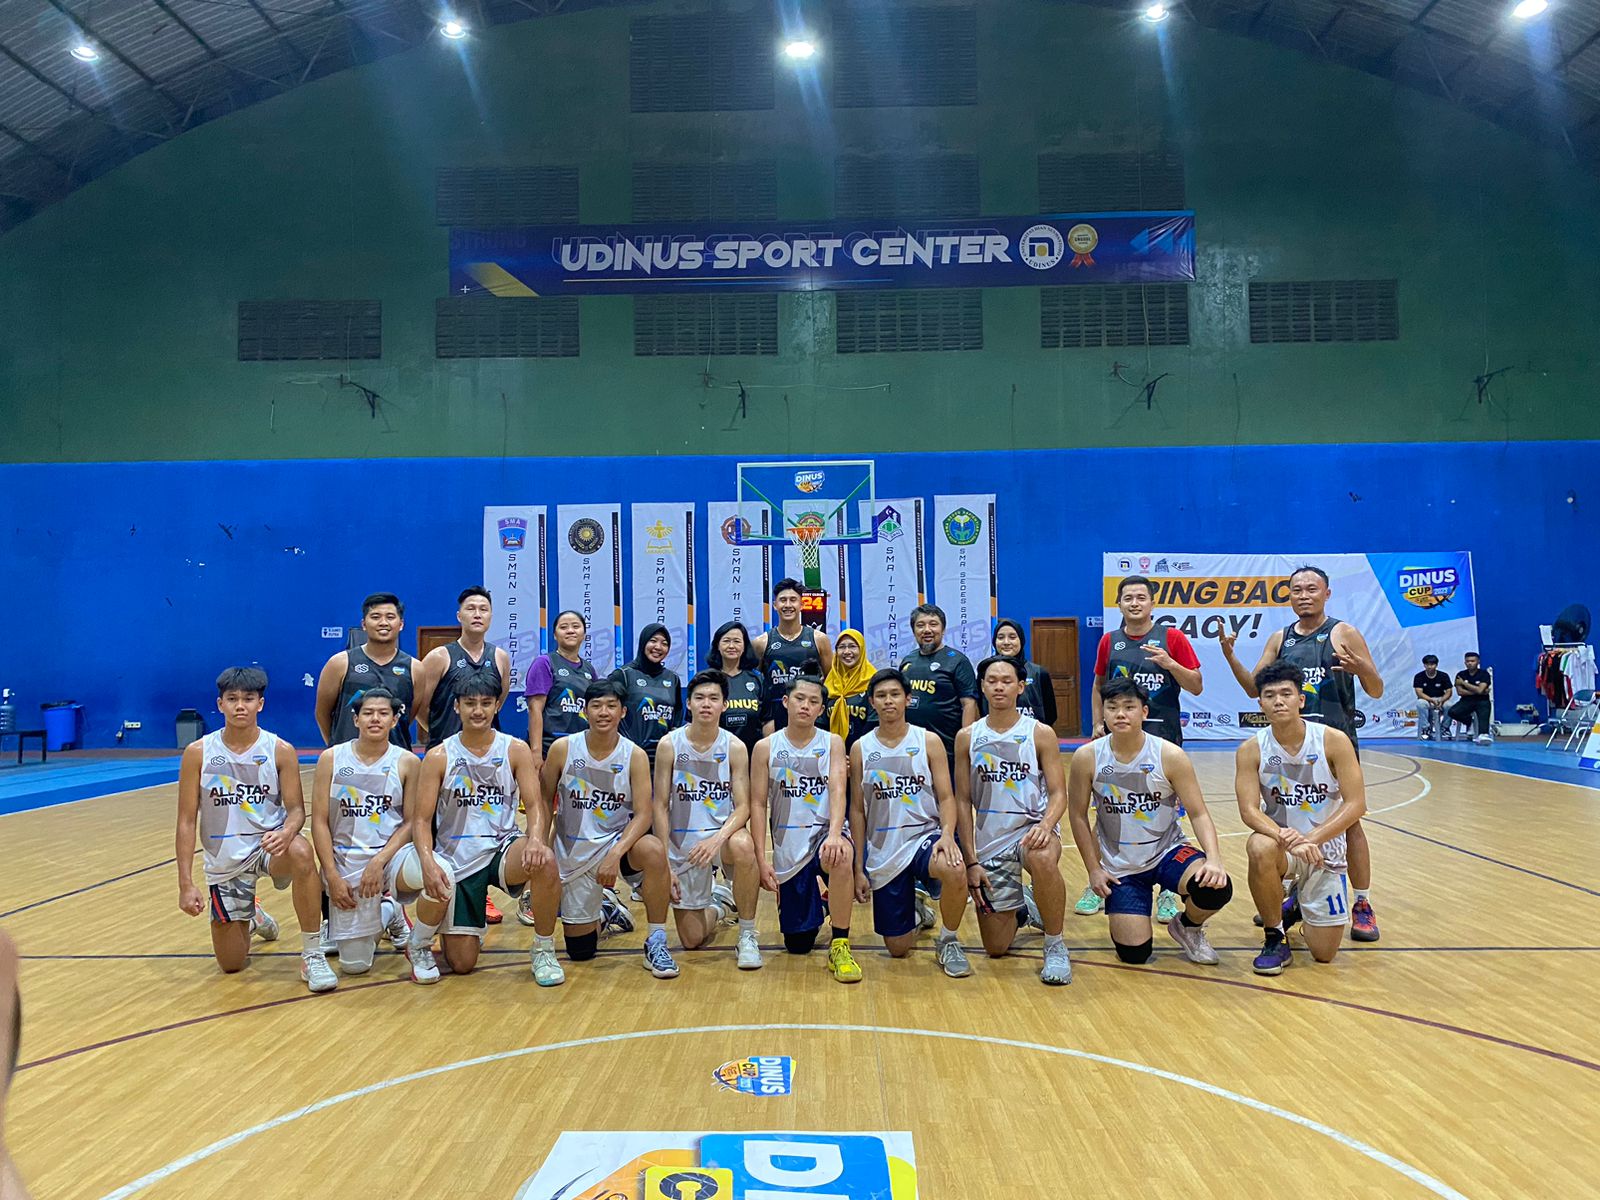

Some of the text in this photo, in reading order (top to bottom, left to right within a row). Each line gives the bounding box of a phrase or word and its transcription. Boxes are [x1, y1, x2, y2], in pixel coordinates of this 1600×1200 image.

[561, 238, 704, 274] UDINUS
[712, 238, 843, 270] SPORT
[851, 232, 1013, 269] CENTER
[1028, 259, 1056, 269] UDINUS
[795, 472, 823, 483] DINUS
[885, 546, 895, 572] SMA
[959, 548, 967, 568] SMA
[582, 557, 591, 580] SMA
[732, 548, 741, 583] SMAN
[1399, 569, 1456, 588] DINUS
[655, 557, 666, 624] SMA KARA
[732, 592, 741, 600] 11
[1223, 579, 1292, 605] BAC
[1409, 586, 1431, 596] CUP
[583, 583, 592, 629] TERANG
[801, 596, 824, 610] 24
[507, 553, 518, 686] SMAN 2 SALATIGA
[887, 595, 897, 630] BINA
[960, 606, 968, 652] SAPIENT
[888, 633, 898, 668] AMAL
[977, 761, 1031, 774] ALL STAR
[676, 780, 731, 793] ALL STAR
[780, 779, 798, 789] ALL
[873, 775, 926, 791] ALL STAR
[1271, 783, 1329, 797] ALL STAR
[209, 784, 271, 798] ALL STAR
[453, 787, 476, 798] ALL
[569, 789, 626, 803] ALL STAR
[678, 791, 729, 802] DINUS CUP
[784, 789, 808, 798] INUS
[875, 789, 903, 800] DINUS
[214, 797, 243, 807] DINUS
[340, 797, 364, 808] ALL
[456, 797, 485, 807] DINUS
[572, 800, 622, 812] DINUS CUP
[1102, 792, 1162, 806] ALL STAR
[1305, 794, 1327, 804] CUP
[342, 808, 374, 818] DINUS
[1105, 802, 1160, 814] DINUS CUP
[1326, 893, 1345, 915] 11
[759, 1057, 786, 1094] DINUS
